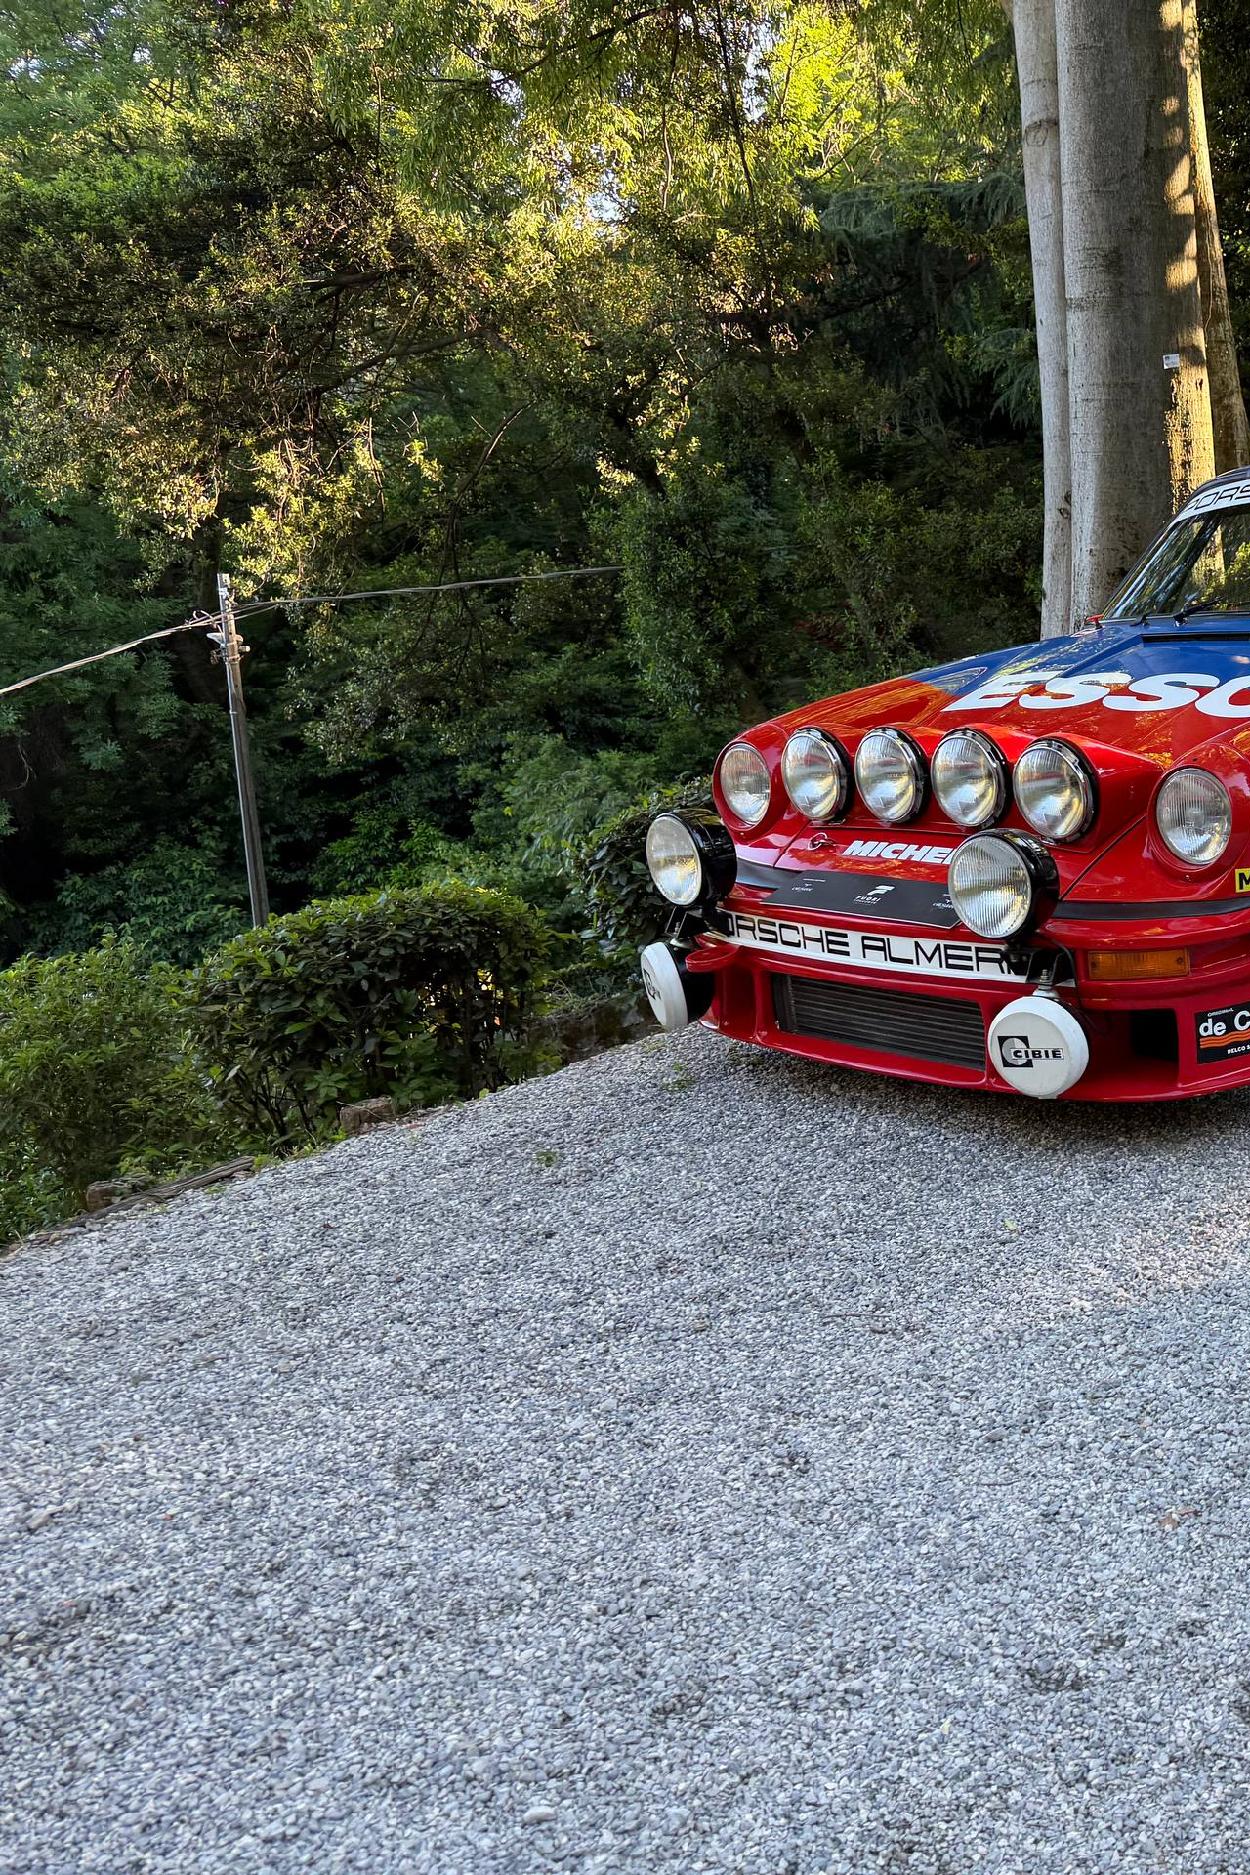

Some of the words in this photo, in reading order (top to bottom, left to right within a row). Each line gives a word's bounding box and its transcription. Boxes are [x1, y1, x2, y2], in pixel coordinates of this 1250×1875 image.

[843, 840, 954, 864] MICHE
[728, 911, 850, 957] RSCHE
[861, 935, 1016, 975] ALMER
[1199, 1018, 1227, 1037] de
